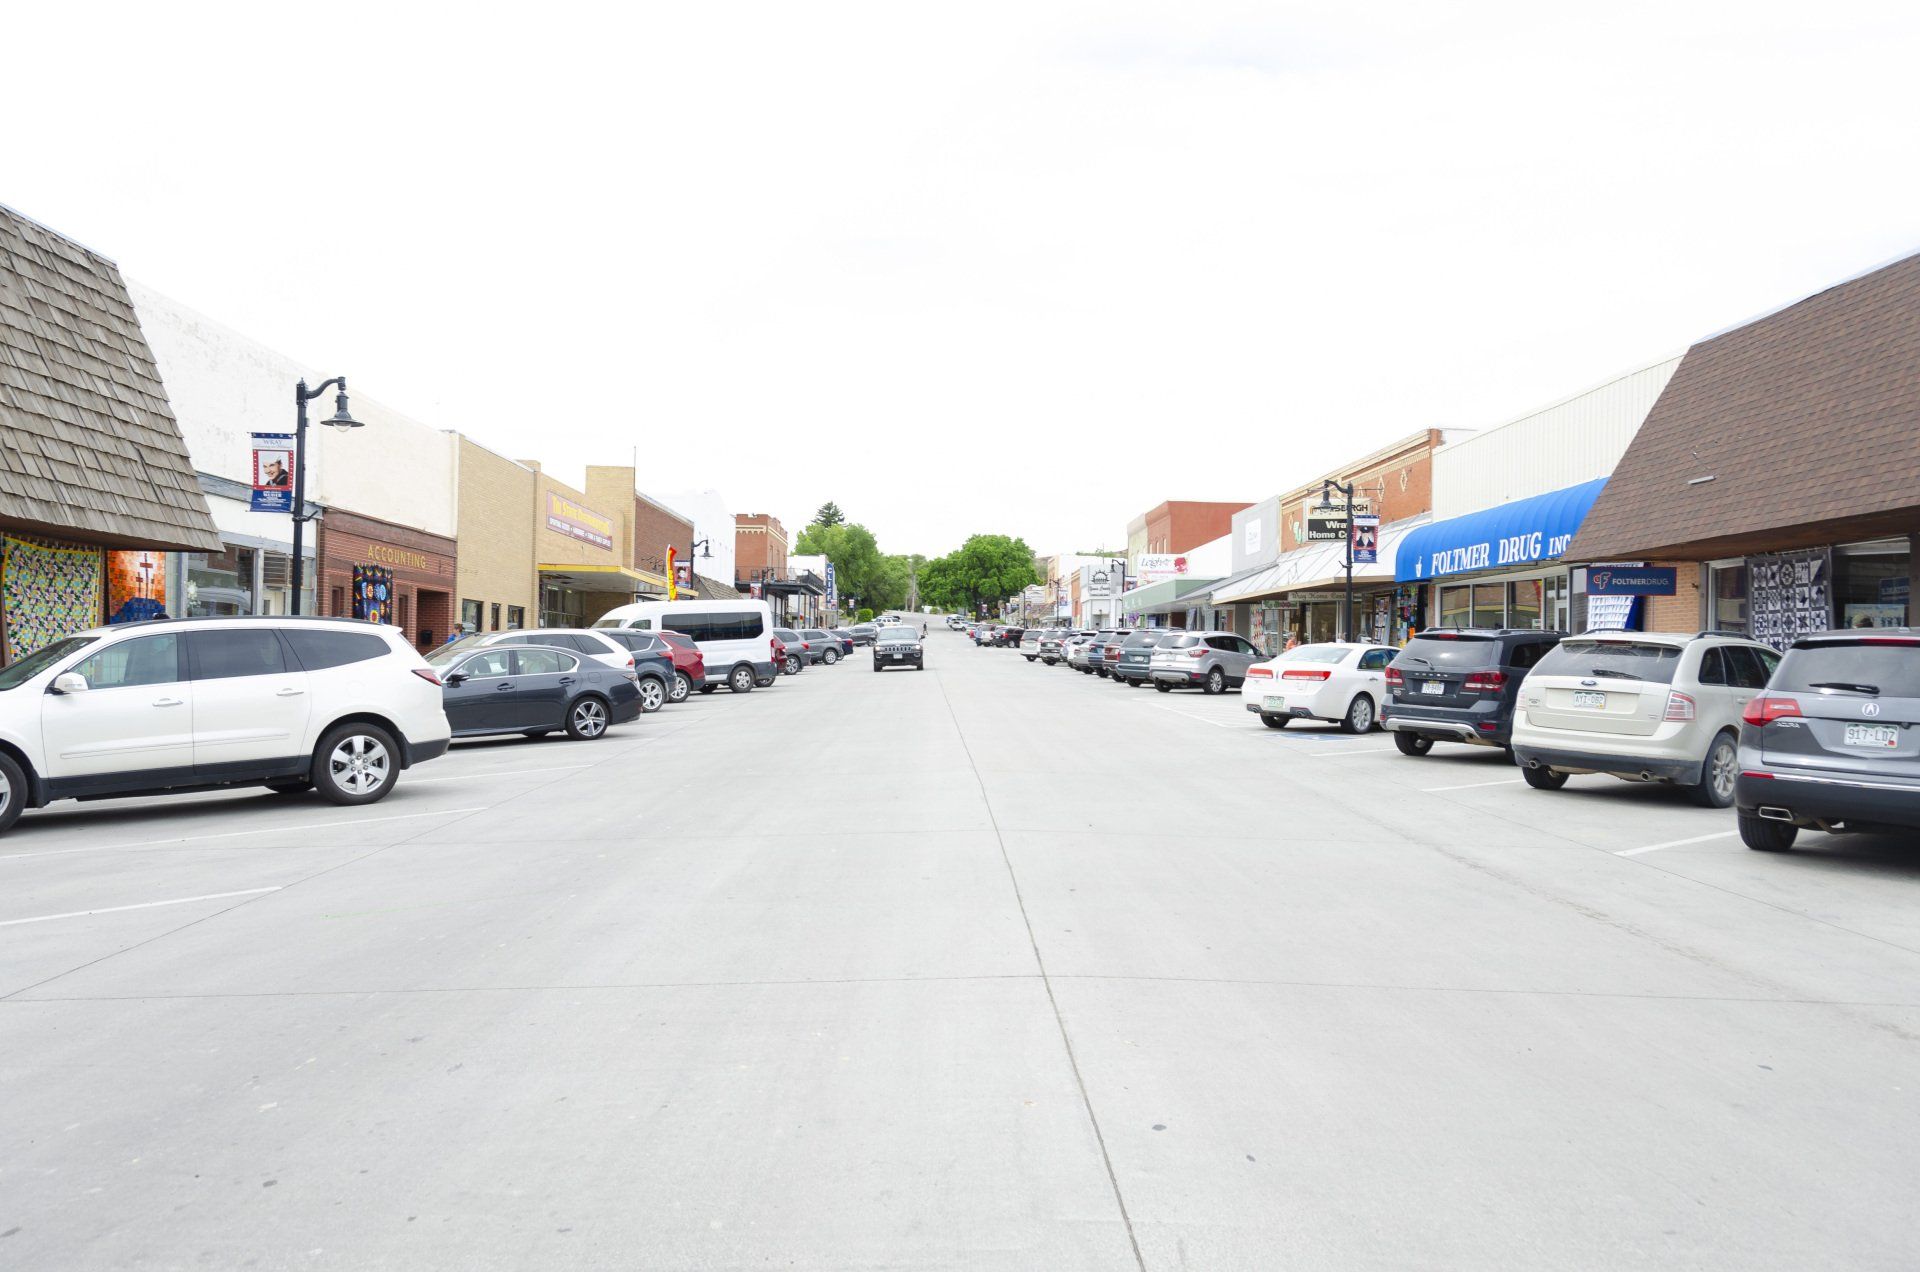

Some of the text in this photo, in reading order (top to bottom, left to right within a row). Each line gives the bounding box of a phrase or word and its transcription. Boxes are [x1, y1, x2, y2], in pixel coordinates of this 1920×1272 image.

[1325, 521, 1347, 529] Wra
[1309, 531, 1336, 539] Home
[368, 544, 426, 568] ACCOUNTING
[1431, 543, 1490, 575] FOLTMER
[1497, 531, 1542, 564] DRUG
